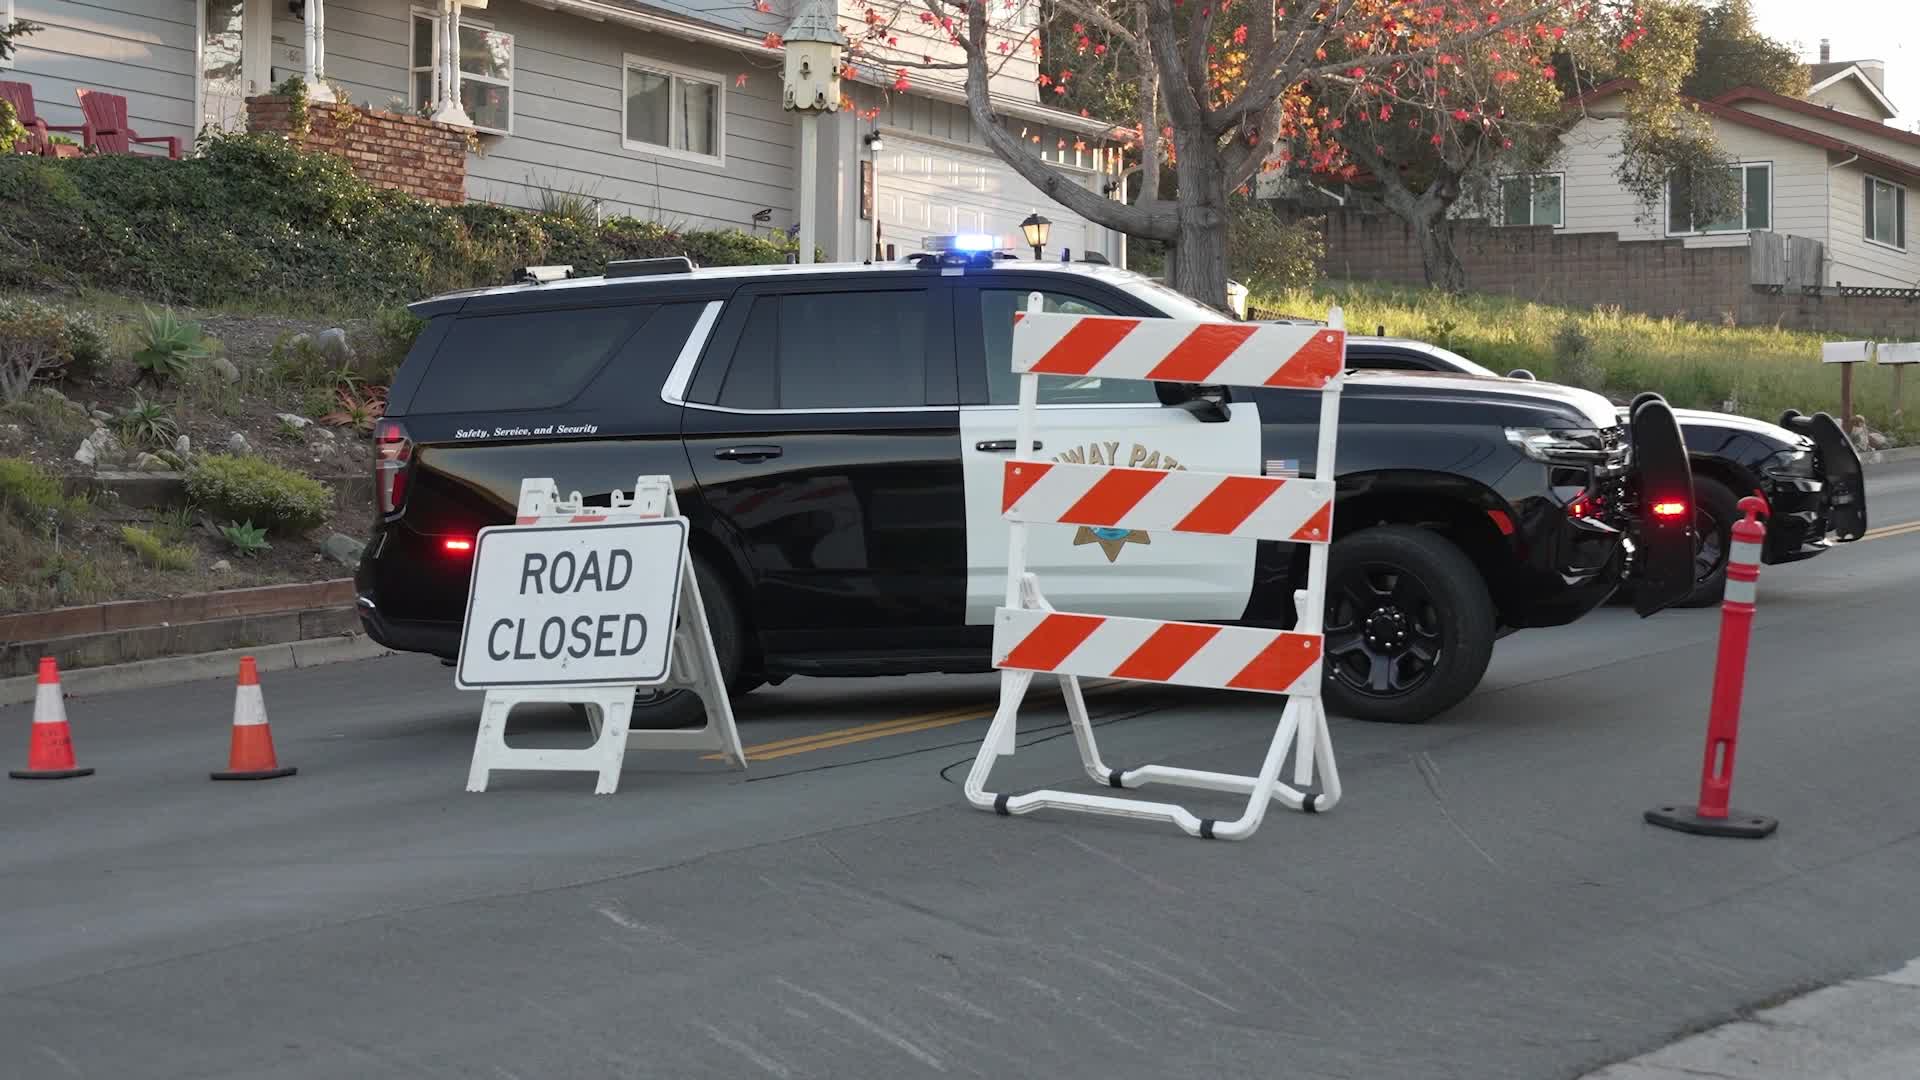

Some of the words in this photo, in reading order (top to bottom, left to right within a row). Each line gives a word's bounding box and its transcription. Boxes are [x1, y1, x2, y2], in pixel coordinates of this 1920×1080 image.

[455, 428, 490, 438] Safety,
[493, 426, 531, 436] Service,
[533, 425, 553, 434] and
[556, 423, 598, 434] Security
[1052, 440, 1120, 466] WAY
[1128, 443, 1186, 471] PAT
[519, 549, 633, 595] ROAD
[487, 613, 648, 661] CLOSED
